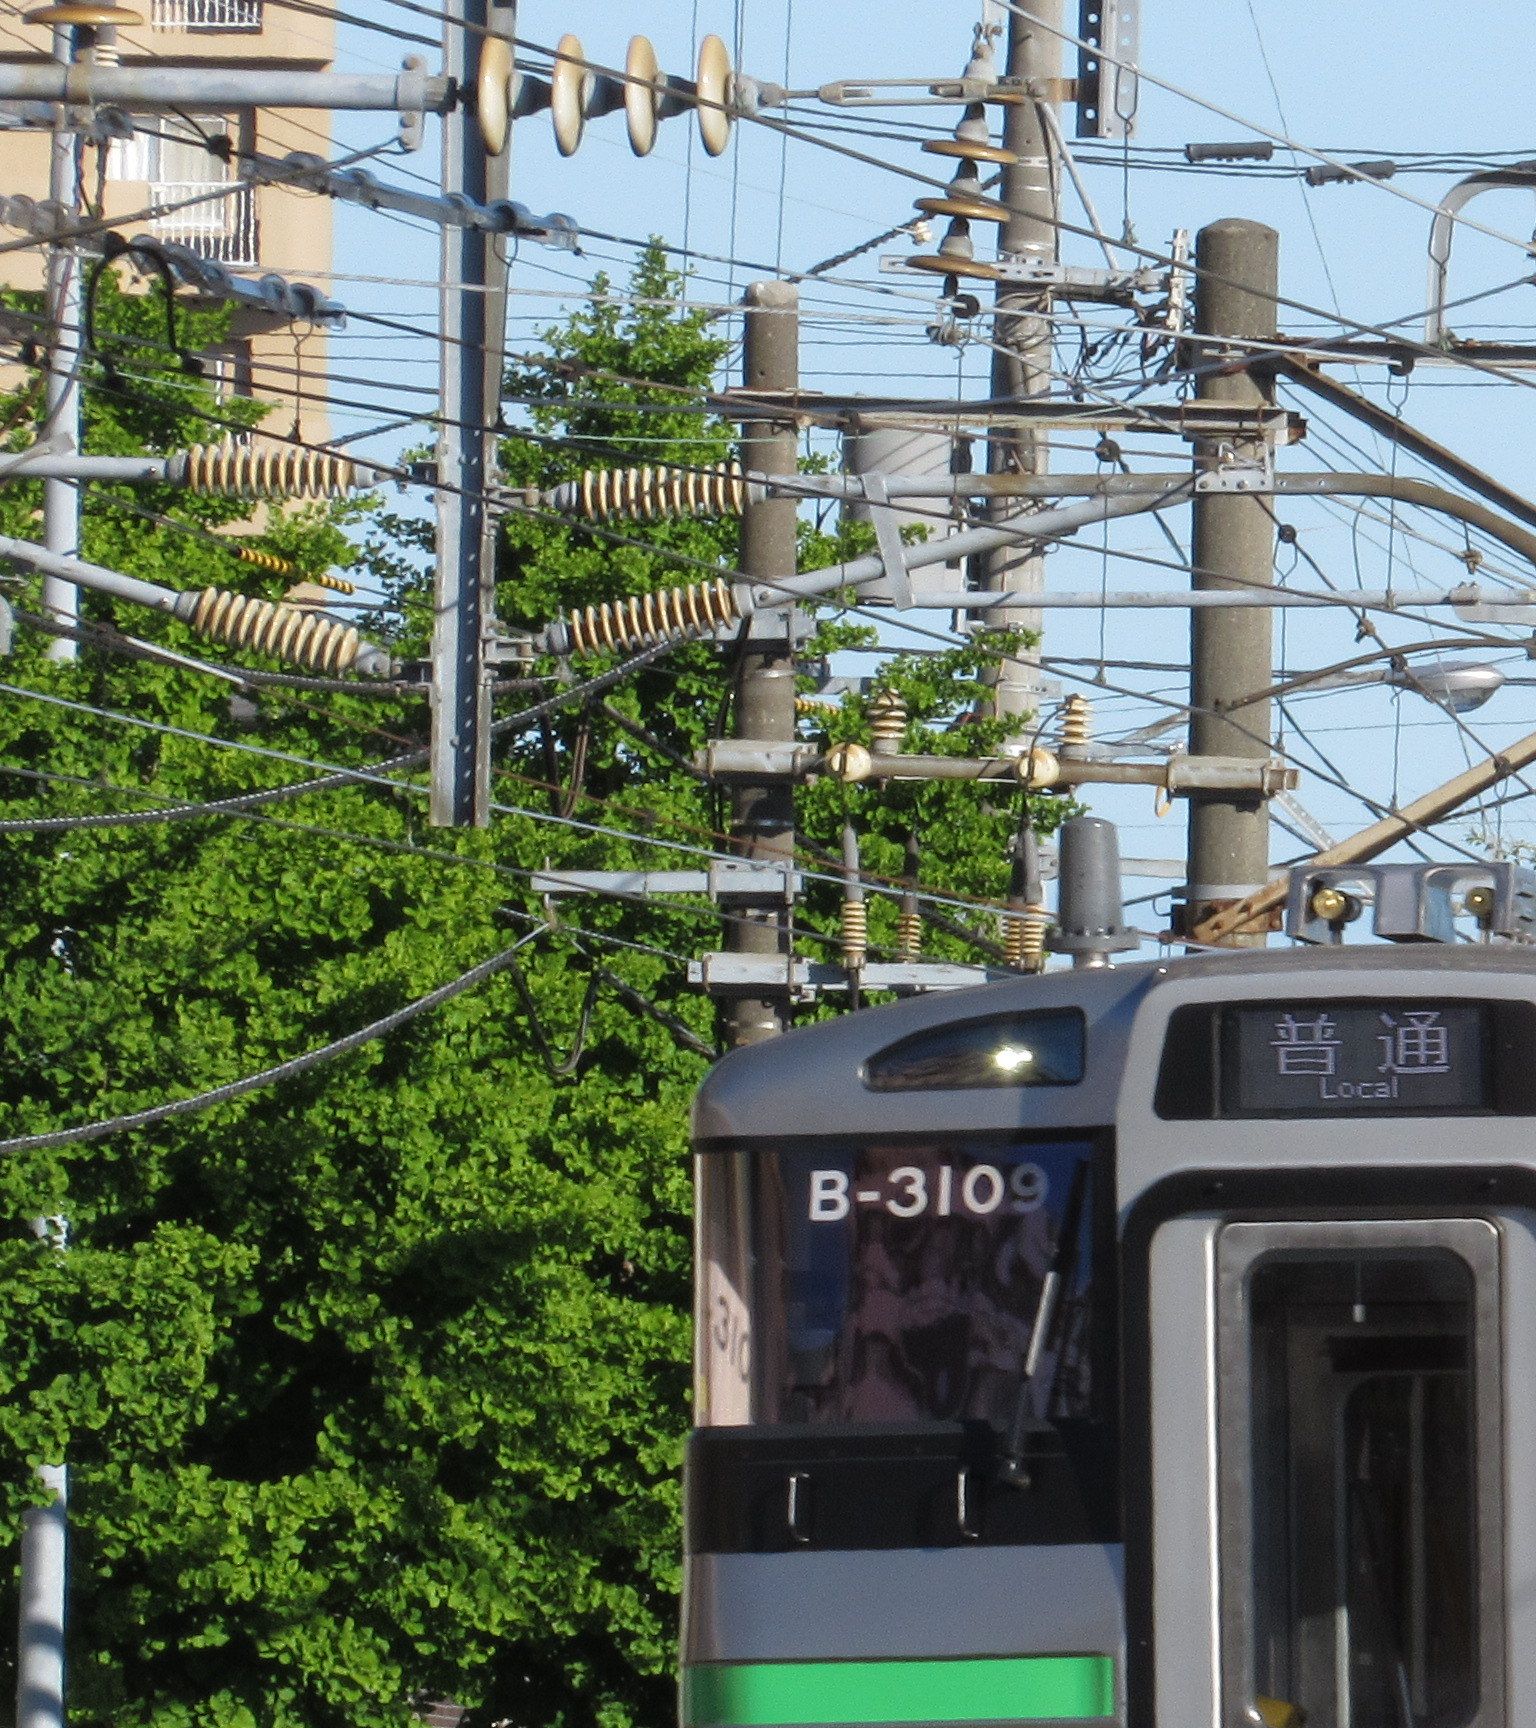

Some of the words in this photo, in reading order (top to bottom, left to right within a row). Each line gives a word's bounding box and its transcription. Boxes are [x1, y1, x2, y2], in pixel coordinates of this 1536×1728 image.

[1270, 1011, 1450, 1075] 普通
[1319, 1076, 1398, 1099] Local
[808, 1162, 1048, 1222] B-3109
